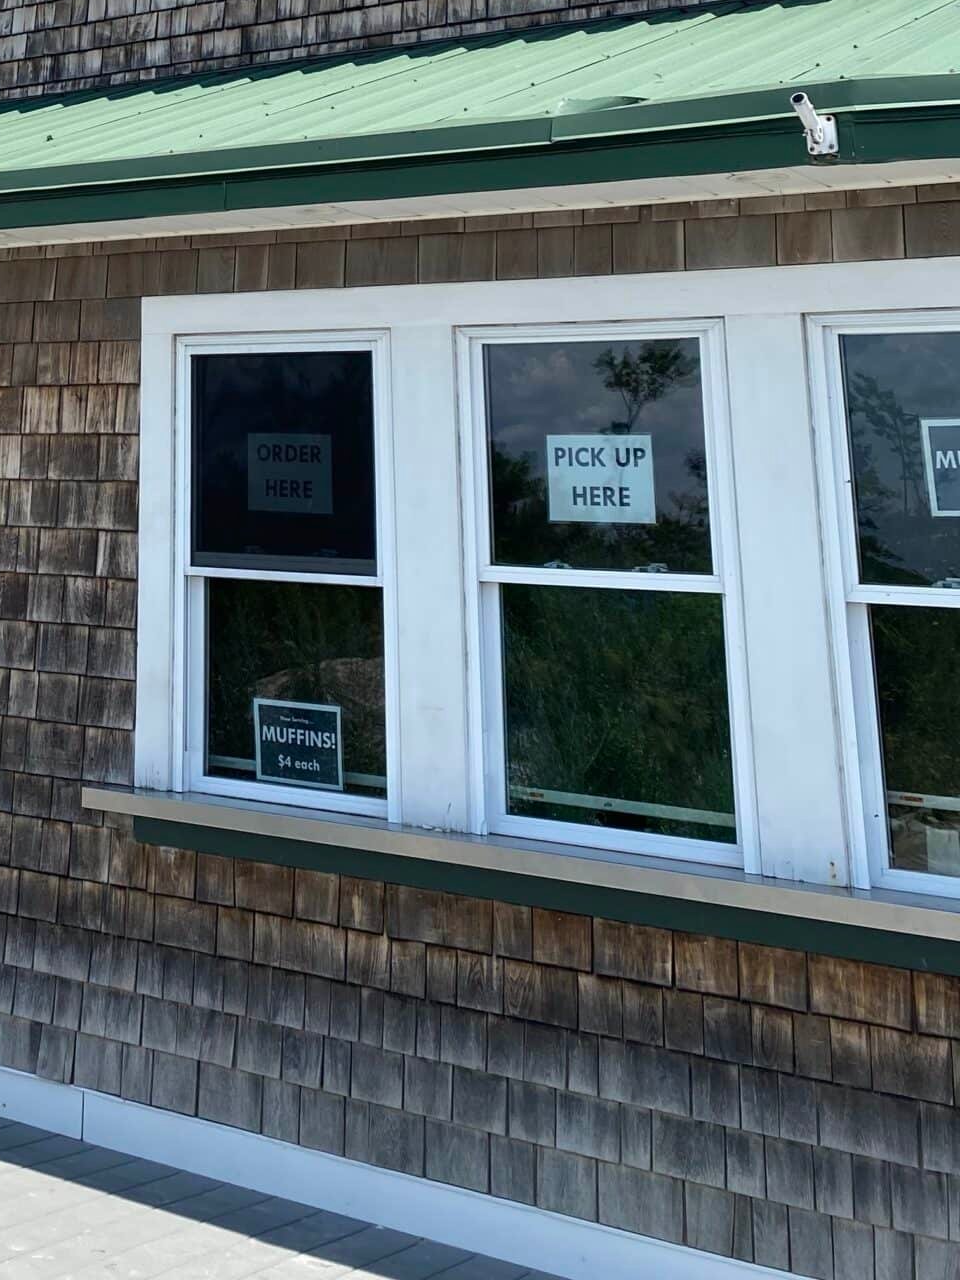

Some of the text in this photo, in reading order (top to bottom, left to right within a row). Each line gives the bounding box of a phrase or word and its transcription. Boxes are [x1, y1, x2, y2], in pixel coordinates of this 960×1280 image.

[257, 443, 322, 464] ORDER
[554, 447, 646, 468] PICK UP
[935, 450, 960, 469] M
[265, 479, 313, 499] HERE
[572, 486, 631, 507] HERE
[262, 725, 336, 749] MUFFINS!
[278, 754, 320, 771] $4 each
